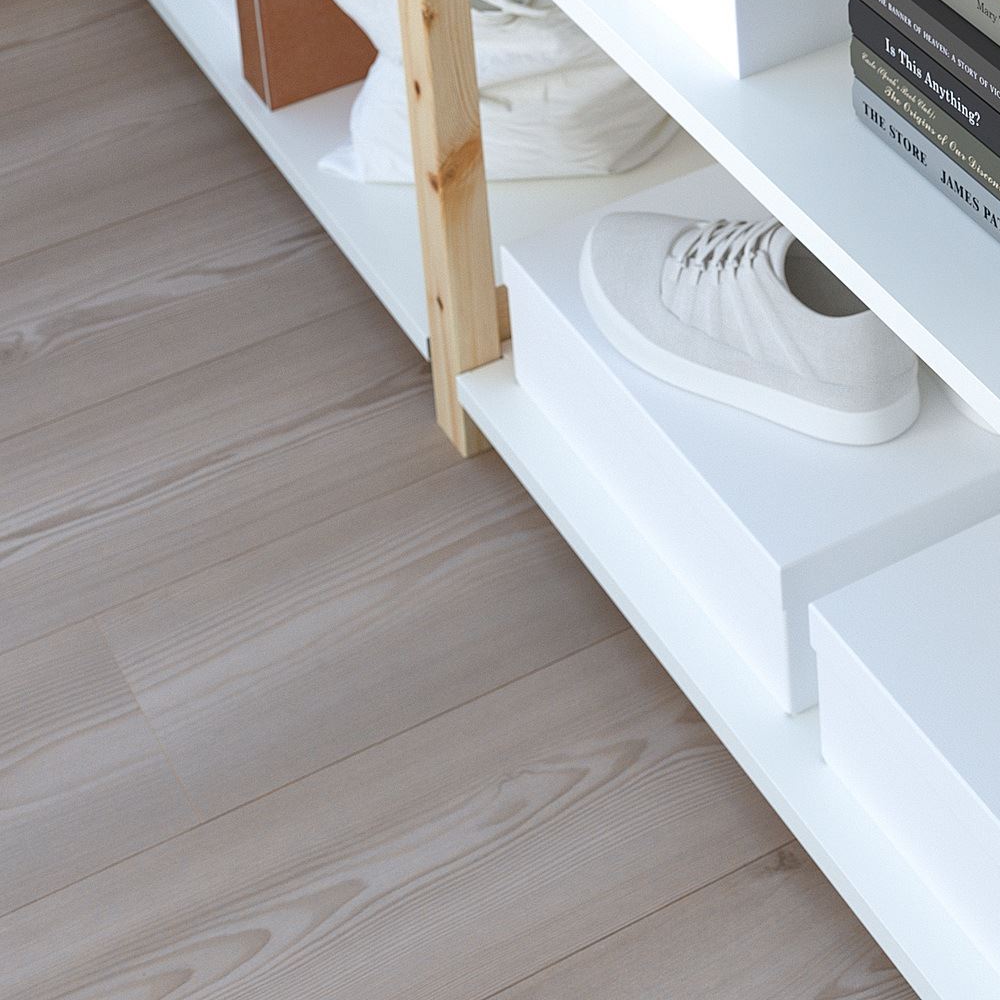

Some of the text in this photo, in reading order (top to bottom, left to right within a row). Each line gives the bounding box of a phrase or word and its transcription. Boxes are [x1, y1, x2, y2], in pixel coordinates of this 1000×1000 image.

[884, 37, 981, 127] Is This Anything?
[888, 2, 912, 27] BANNER
[913, 23, 921, 34] OF
[923, 30, 950, 58] HEAVEN:
[951, 54, 957, 63] A
[957, 59, 978, 80] STORY
[979, 76, 989, 88] OF
[862, 100, 886, 131] THE
[888, 124, 928, 167] STORE
[940, 170, 980, 211] JAMES
[884, 85, 902, 106] The
[903, 101, 935, 135] Origins
[937, 133, 948, 146] of
[949, 140, 967, 161] Our
